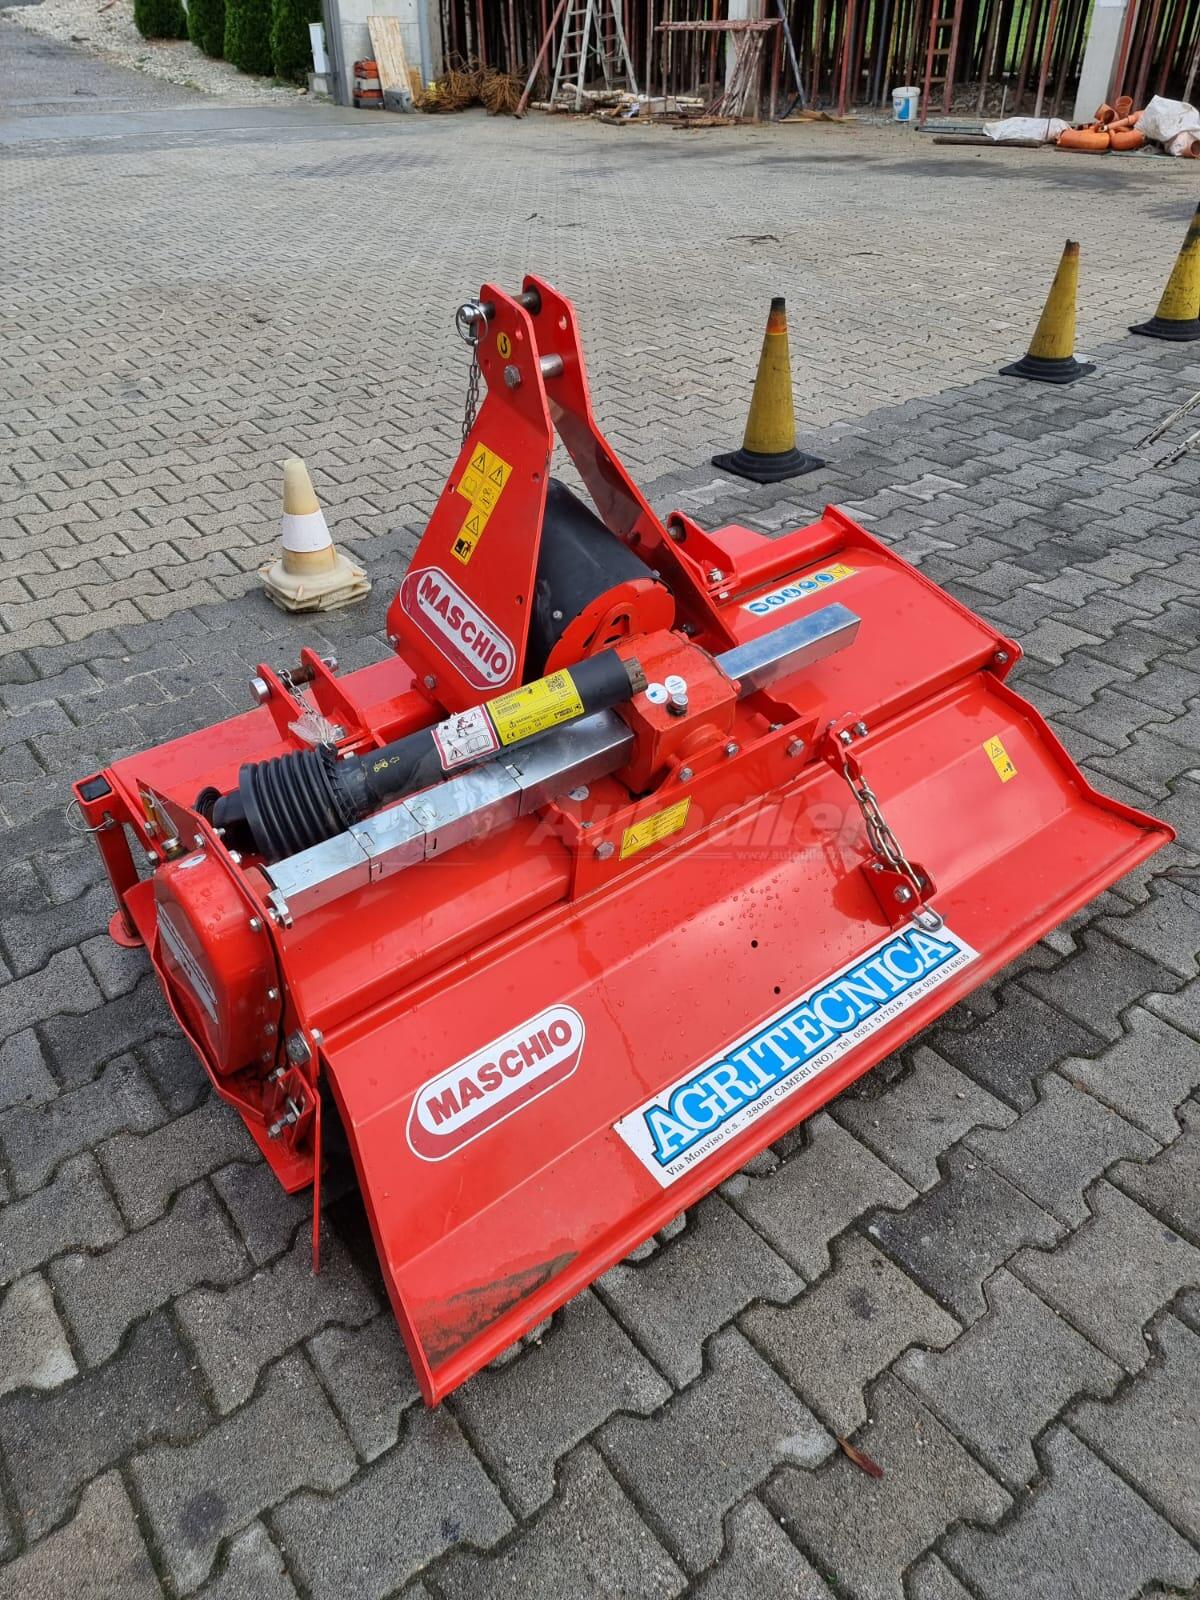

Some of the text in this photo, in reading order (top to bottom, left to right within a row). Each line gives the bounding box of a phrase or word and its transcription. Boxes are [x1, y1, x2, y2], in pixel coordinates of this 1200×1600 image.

[418, 574, 508, 675] MASCHIO
[425, 1018, 573, 1127] MASCHIO
[647, 931, 956, 1161] AGRITECNICA
[666, 1163, 685, 1176] Via
[684, 1133, 724, 1165] Monviso
[724, 1121, 741, 1135] c.s.
[745, 1095, 775, 1118] 28062
[774, 1066, 812, 1097] CAMERI
[811, 1051, 834, 1071] (NO)
[837, 1037, 853, 1051] Tel.
[853, 1021, 875, 1039] 0321
[874, 1000, 904, 1023] 517518
[907, 987, 924, 1000] Fax
[922, 973, 944, 988] 0321
